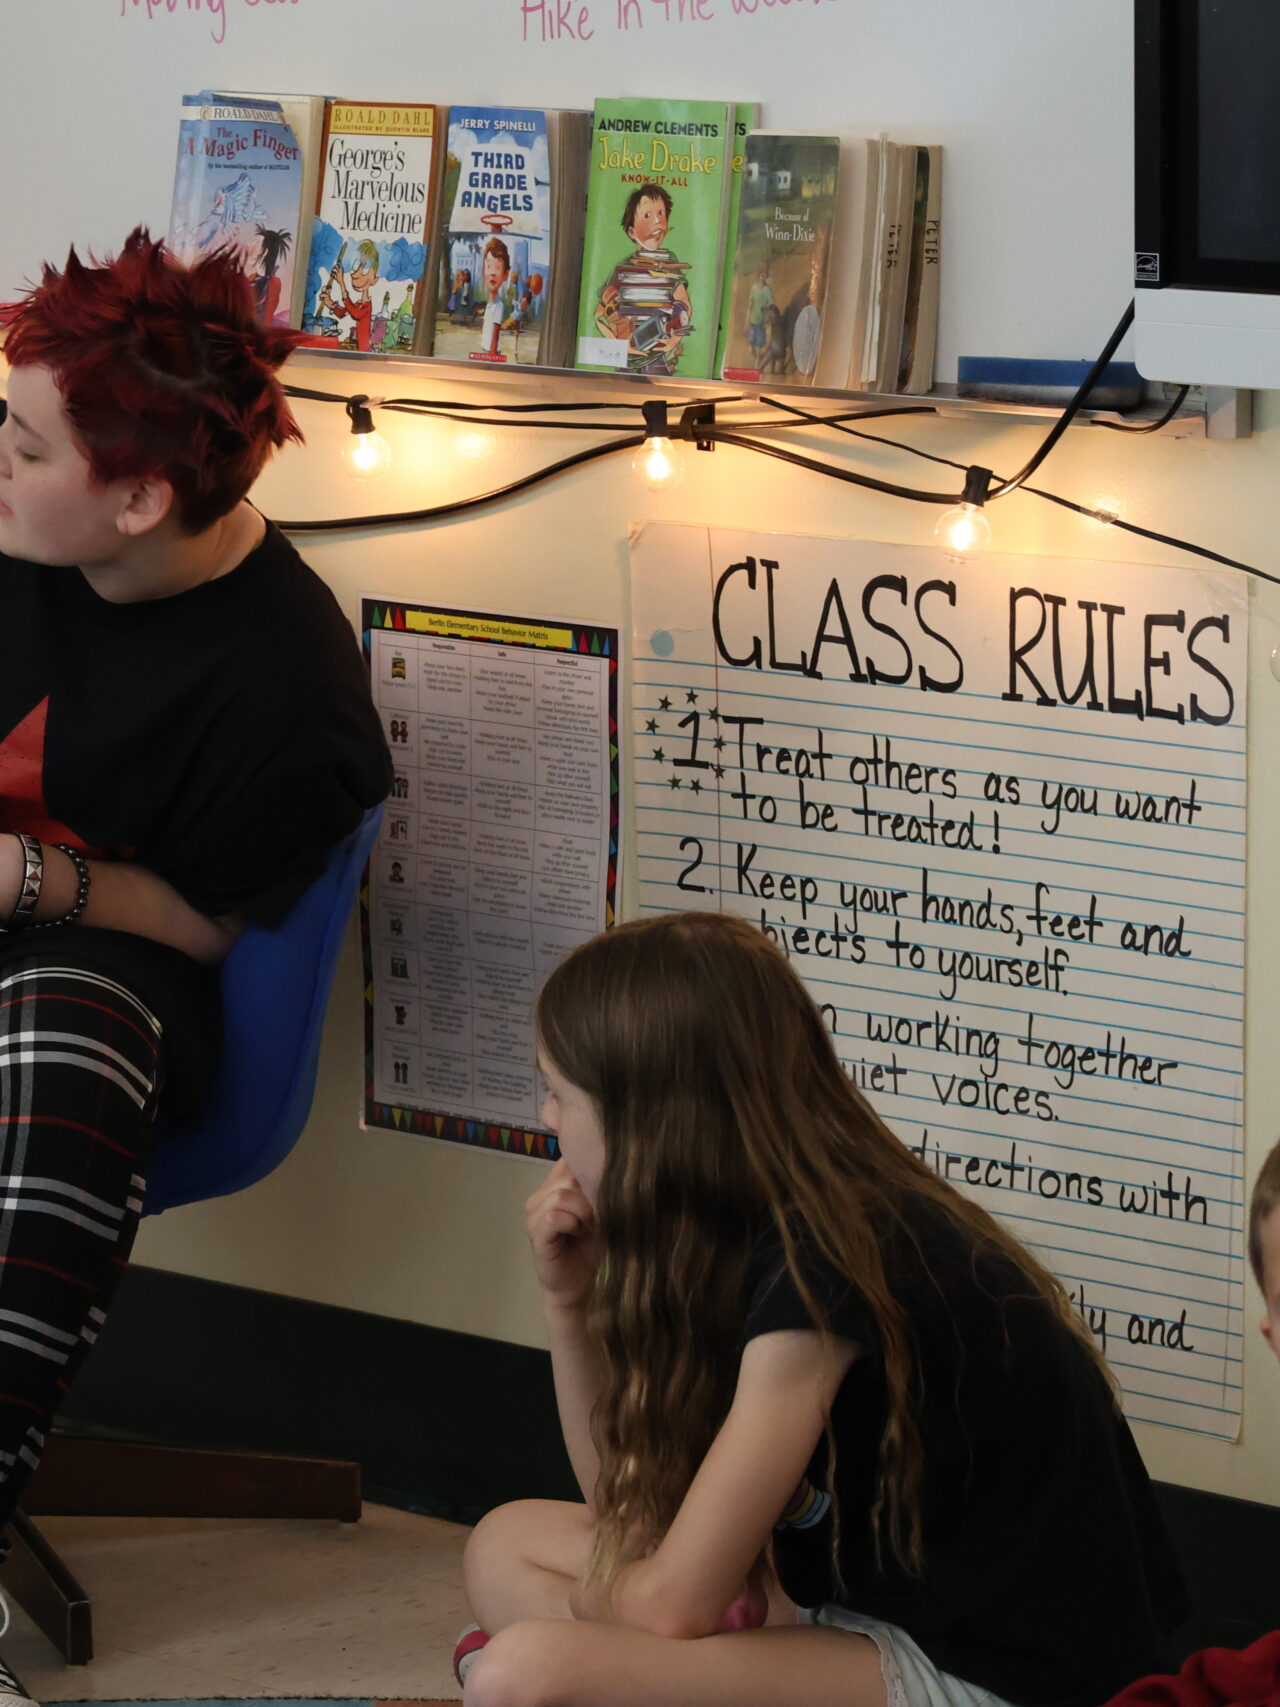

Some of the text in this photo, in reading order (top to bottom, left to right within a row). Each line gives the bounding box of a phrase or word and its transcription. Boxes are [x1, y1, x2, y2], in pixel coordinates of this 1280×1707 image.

[521, 0, 594, 42] Hike
[214, 107, 279, 122] ROALD DAHL
[334, 108, 431, 126] ROALD DAHL
[460, 118, 536, 132] JERRY SPINELLI
[598, 118, 652, 133] ANDREW
[654, 121, 718, 137] CLEMENTS
[204, 134, 249, 160] Magic
[252, 128, 299, 161] Finger
[216, 126, 233, 138] The
[329, 138, 405, 178] George's
[471, 151, 525, 170] THIRD
[599, 136, 646, 170] Jake
[651, 140, 716, 174] Drake
[331, 169, 425, 203] Marvelous
[468, 171, 527, 191] GRADE
[621, 173, 688, 187] KNOW-IT-ALL
[340, 201, 422, 234] Medicine
[461, 190, 533, 213] ANGELS
[765, 222, 816, 242] Winn-Dixie
[446, 620, 480, 632] Elementary
[480, 624, 500, 634] School
[501, 626, 527, 638] Behavior
[528, 630, 549, 640] Matrix
[713, 556, 1235, 726] CLASS RULES
[721, 714, 833, 782] Treat
[850, 734, 957, 798] others
[983, 770, 1021, 805] as
[1041, 780, 1098, 834] you
[1115, 780, 1202, 825] want
[731, 771, 1002, 854] to be treated!
[676, 837, 1192, 957] 2. Keep your hands, feet and
[761, 908, 1070, 1000] bjects to yourself.
[867, 1010, 1000, 1078] working
[1017, 1013, 1178, 1089] together
[842, 1052, 1059, 1121] uiet voices.
[1120, 1171, 1207, 1225] with
[1128, 1308, 1194, 1351] and
